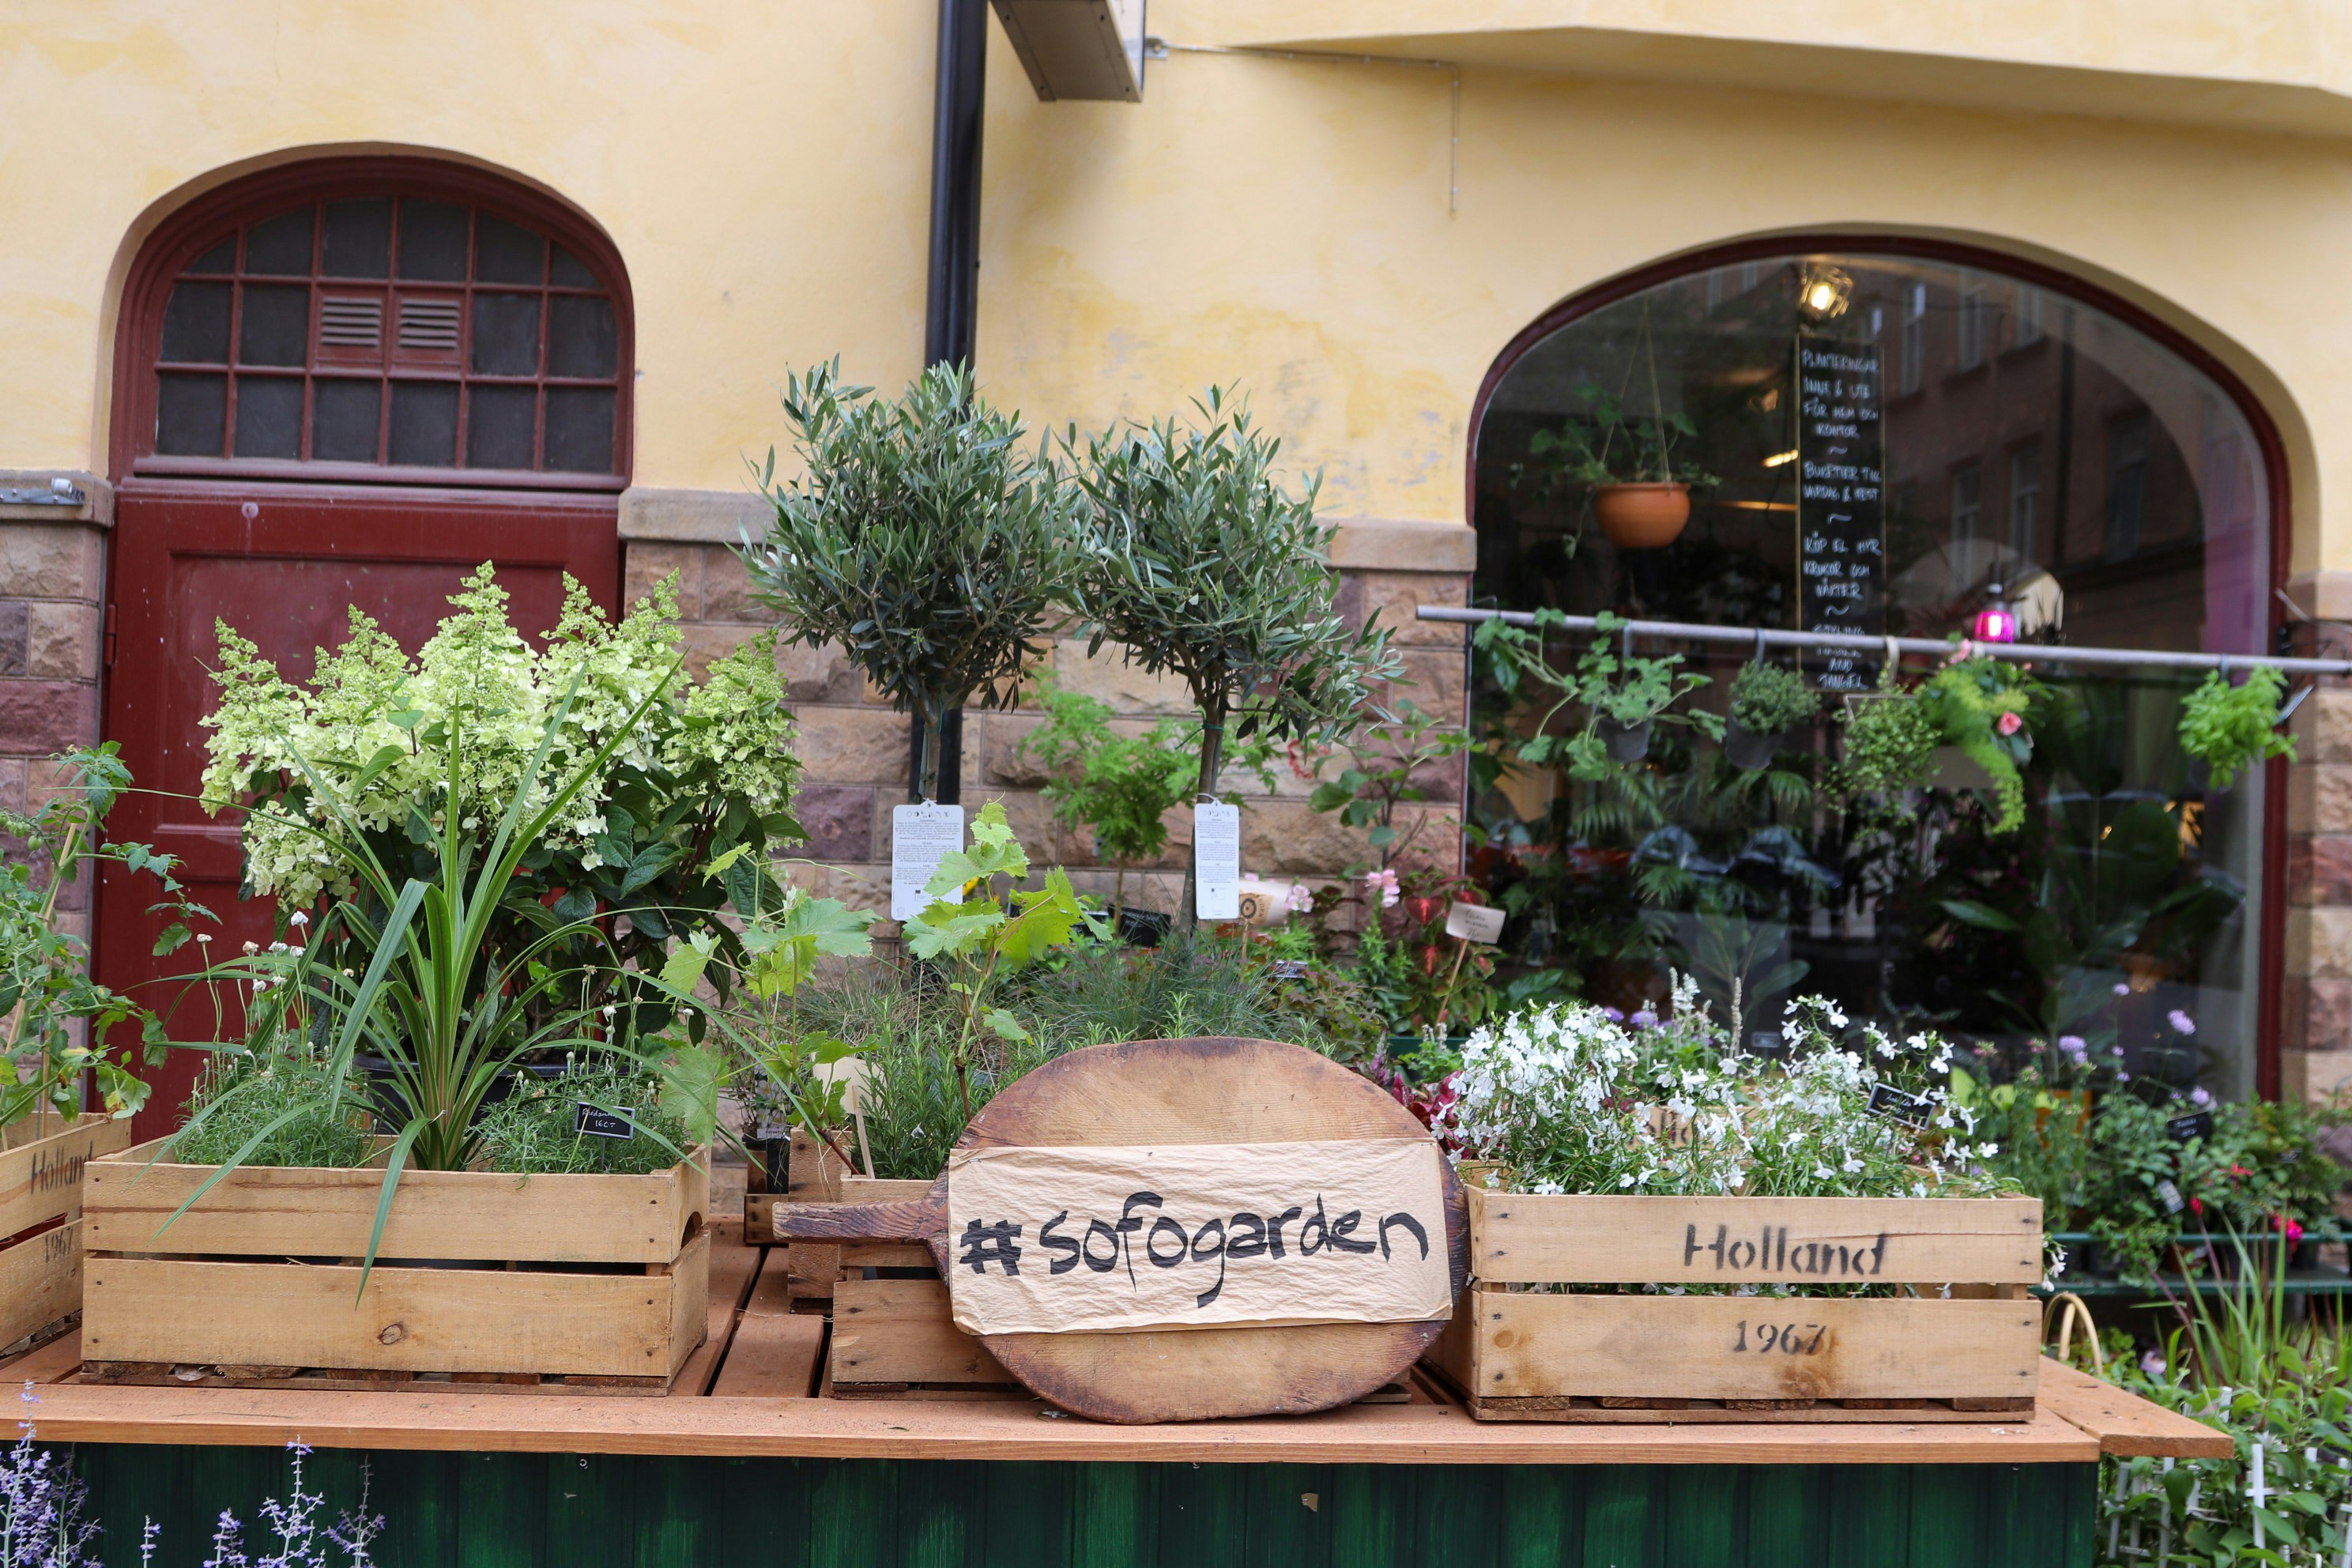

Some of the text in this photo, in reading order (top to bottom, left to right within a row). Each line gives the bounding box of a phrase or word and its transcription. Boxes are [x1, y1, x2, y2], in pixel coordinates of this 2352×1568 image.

[1849, 384, 1870, 399] UTE
[1833, 405, 1855, 420] HEM
[1816, 423, 1860, 439] KONTOR
[1804, 462, 1859, 481] BUKETTER
[1803, 485, 1840, 500] VARDAG
[1833, 538, 1849, 552] EL
[1856, 539, 1882, 556] HYR
[1804, 560, 1843, 577] KRUKOR
[30, 1139, 93, 1196] Holland
[1684, 1223, 1888, 1276] Holland
[1734, 1320, 1826, 1355] 1967
